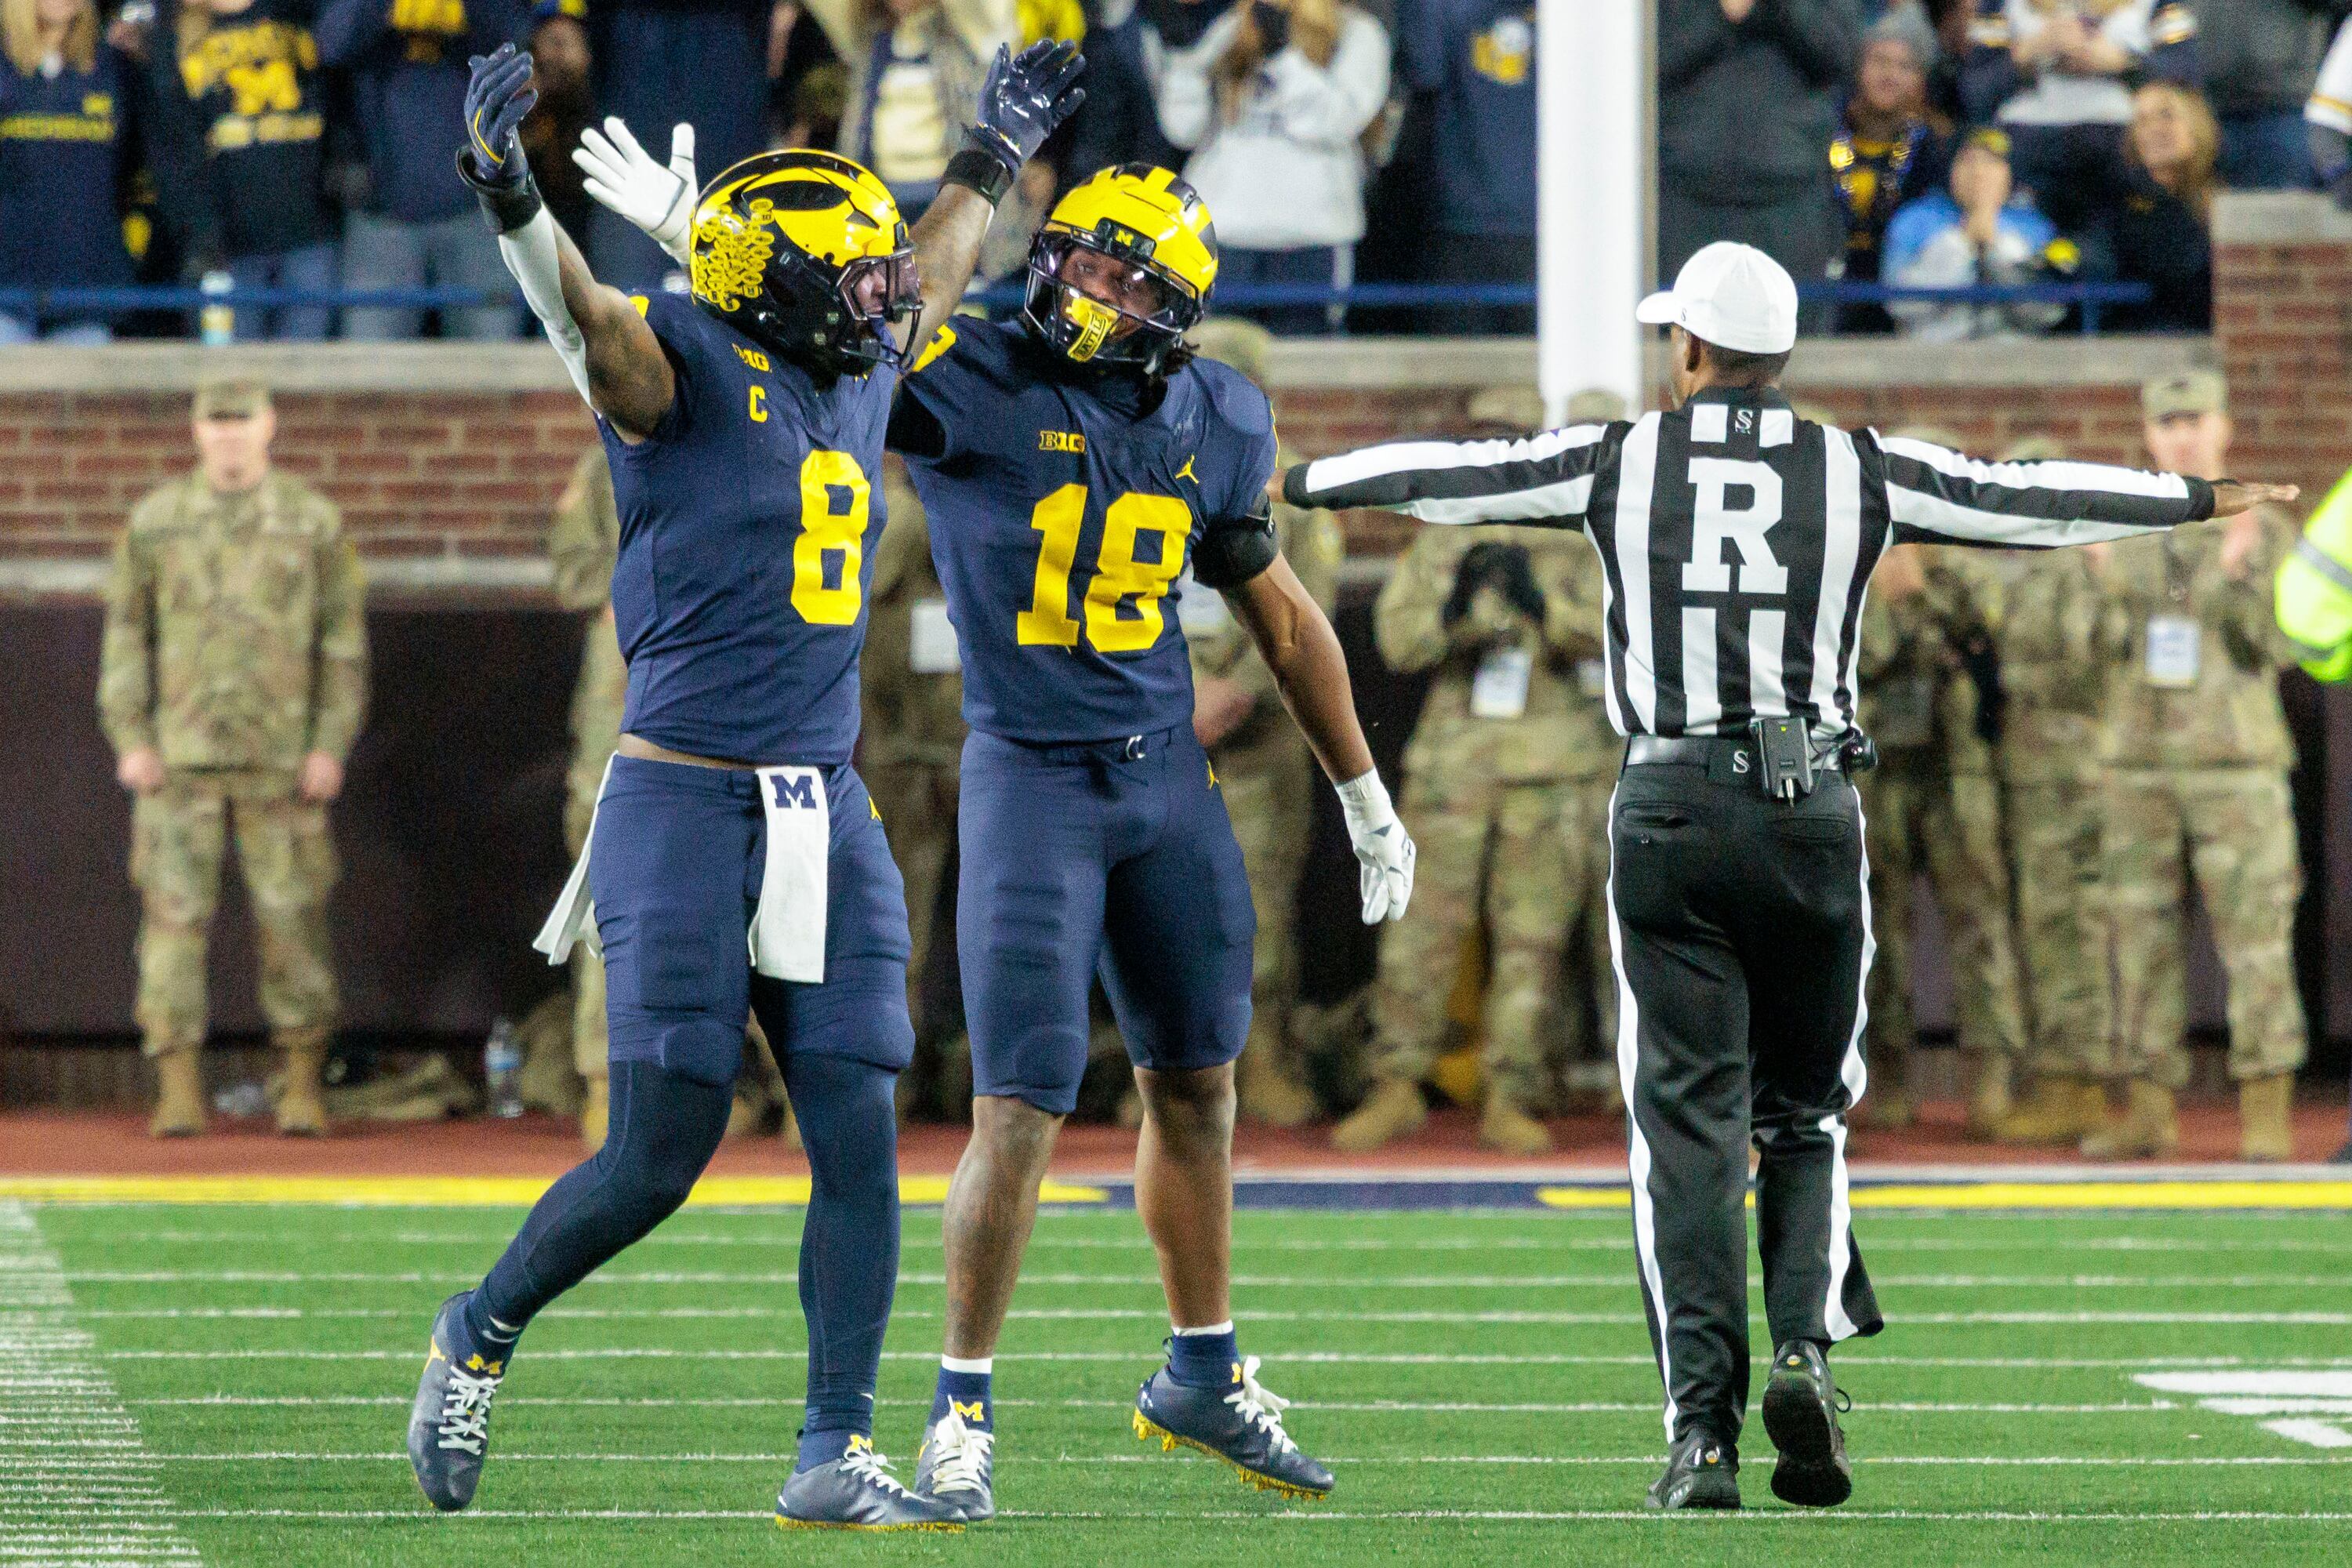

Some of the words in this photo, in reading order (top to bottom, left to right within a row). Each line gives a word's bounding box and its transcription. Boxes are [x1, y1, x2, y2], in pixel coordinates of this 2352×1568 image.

[1116, 229, 1134, 247] M
[750, 385, 768, 423] C
[790, 449, 871, 626] 8
[1682, 456, 1788, 594] R
[1017, 482, 1193, 653] 18
[1733, 750, 1750, 774] S
[769, 775, 817, 809] M
[466, 1353, 503, 1375] M
[953, 1400, 985, 1422] M
